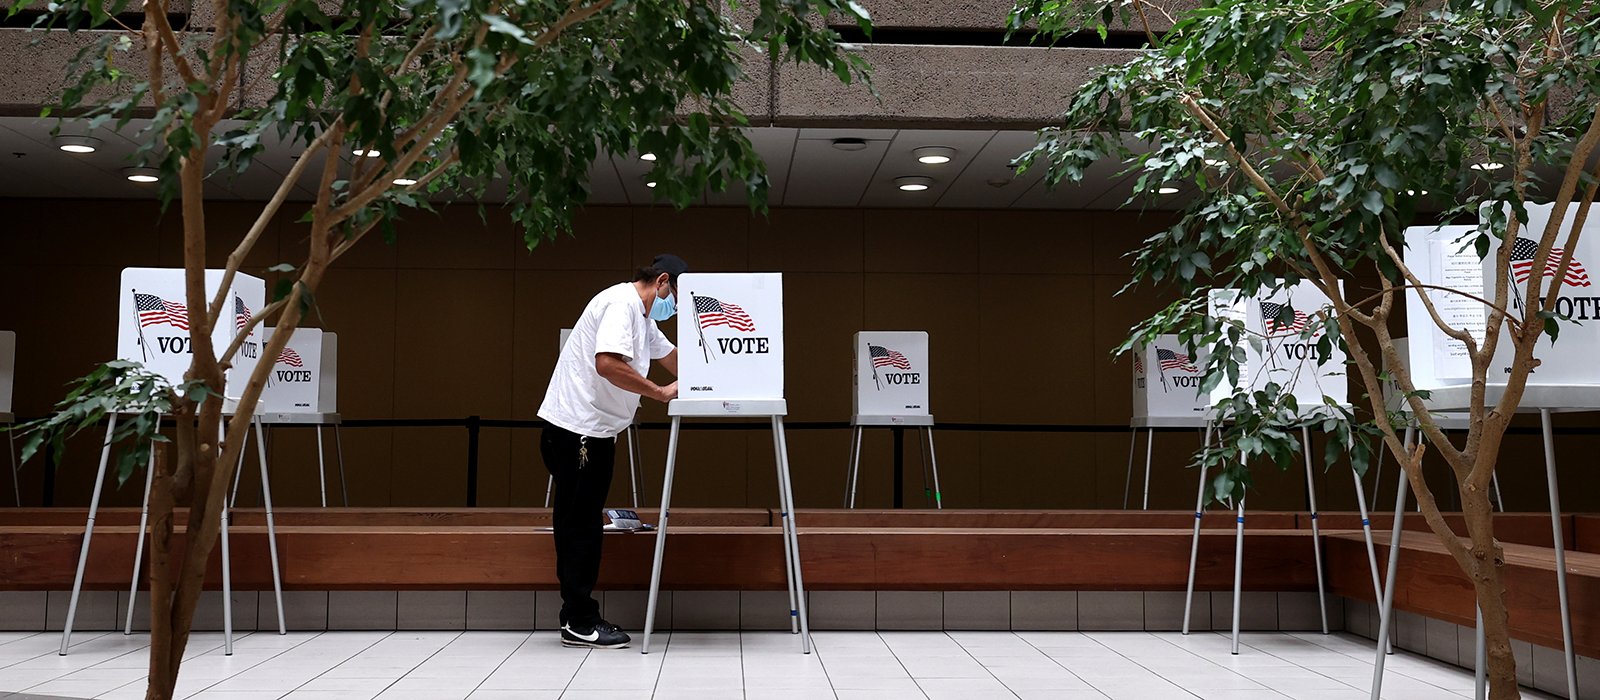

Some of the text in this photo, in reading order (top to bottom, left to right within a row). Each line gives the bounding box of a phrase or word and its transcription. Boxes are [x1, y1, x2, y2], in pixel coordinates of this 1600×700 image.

[157, 336, 194, 354] VOT
[717, 337, 769, 354] VOTE
[276, 370, 312, 382] VOTE
[885, 372, 921, 385] VOTE
[1172, 376, 1202, 388] VOT
